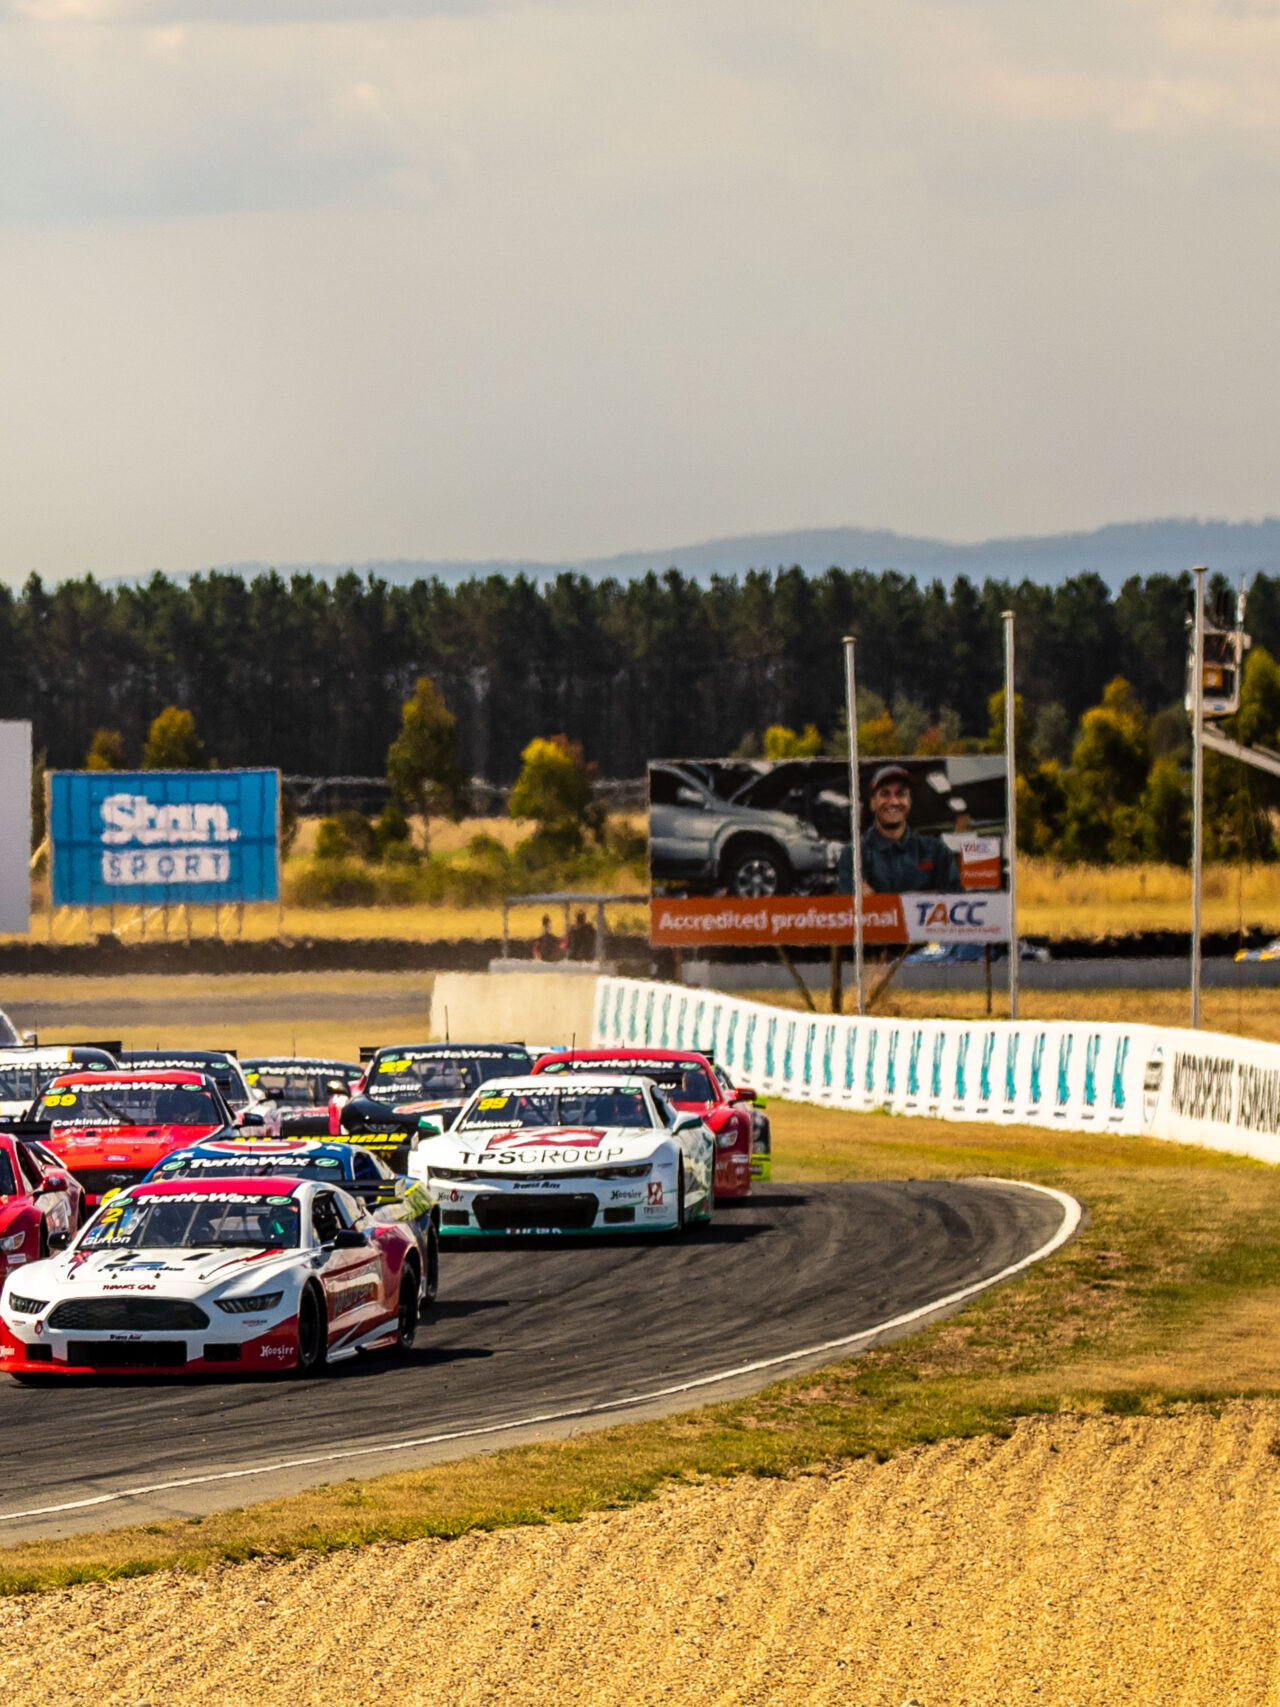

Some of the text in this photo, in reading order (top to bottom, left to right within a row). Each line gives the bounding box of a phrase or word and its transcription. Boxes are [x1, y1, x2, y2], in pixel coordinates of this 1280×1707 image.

[109, 855, 224, 879] SPORT
[658, 910, 770, 931] Accredited
[916, 901, 988, 927] TACC
[118, 1059, 207, 1069] urtleWax
[378, 1060, 413, 1073] 27
[70, 1081, 178, 1093] TurtleWax
[370, 1084, 422, 1095] Barbour
[477, 1096, 509, 1111] 99
[53, 1117, 120, 1128] Corkindale
[189, 1156, 311, 1169] TurtleWax
[136, 1192, 262, 1205] TurtleWax
[101, 1208, 124, 1224] 2
[83, 1235, 132, 1247] Gurton
